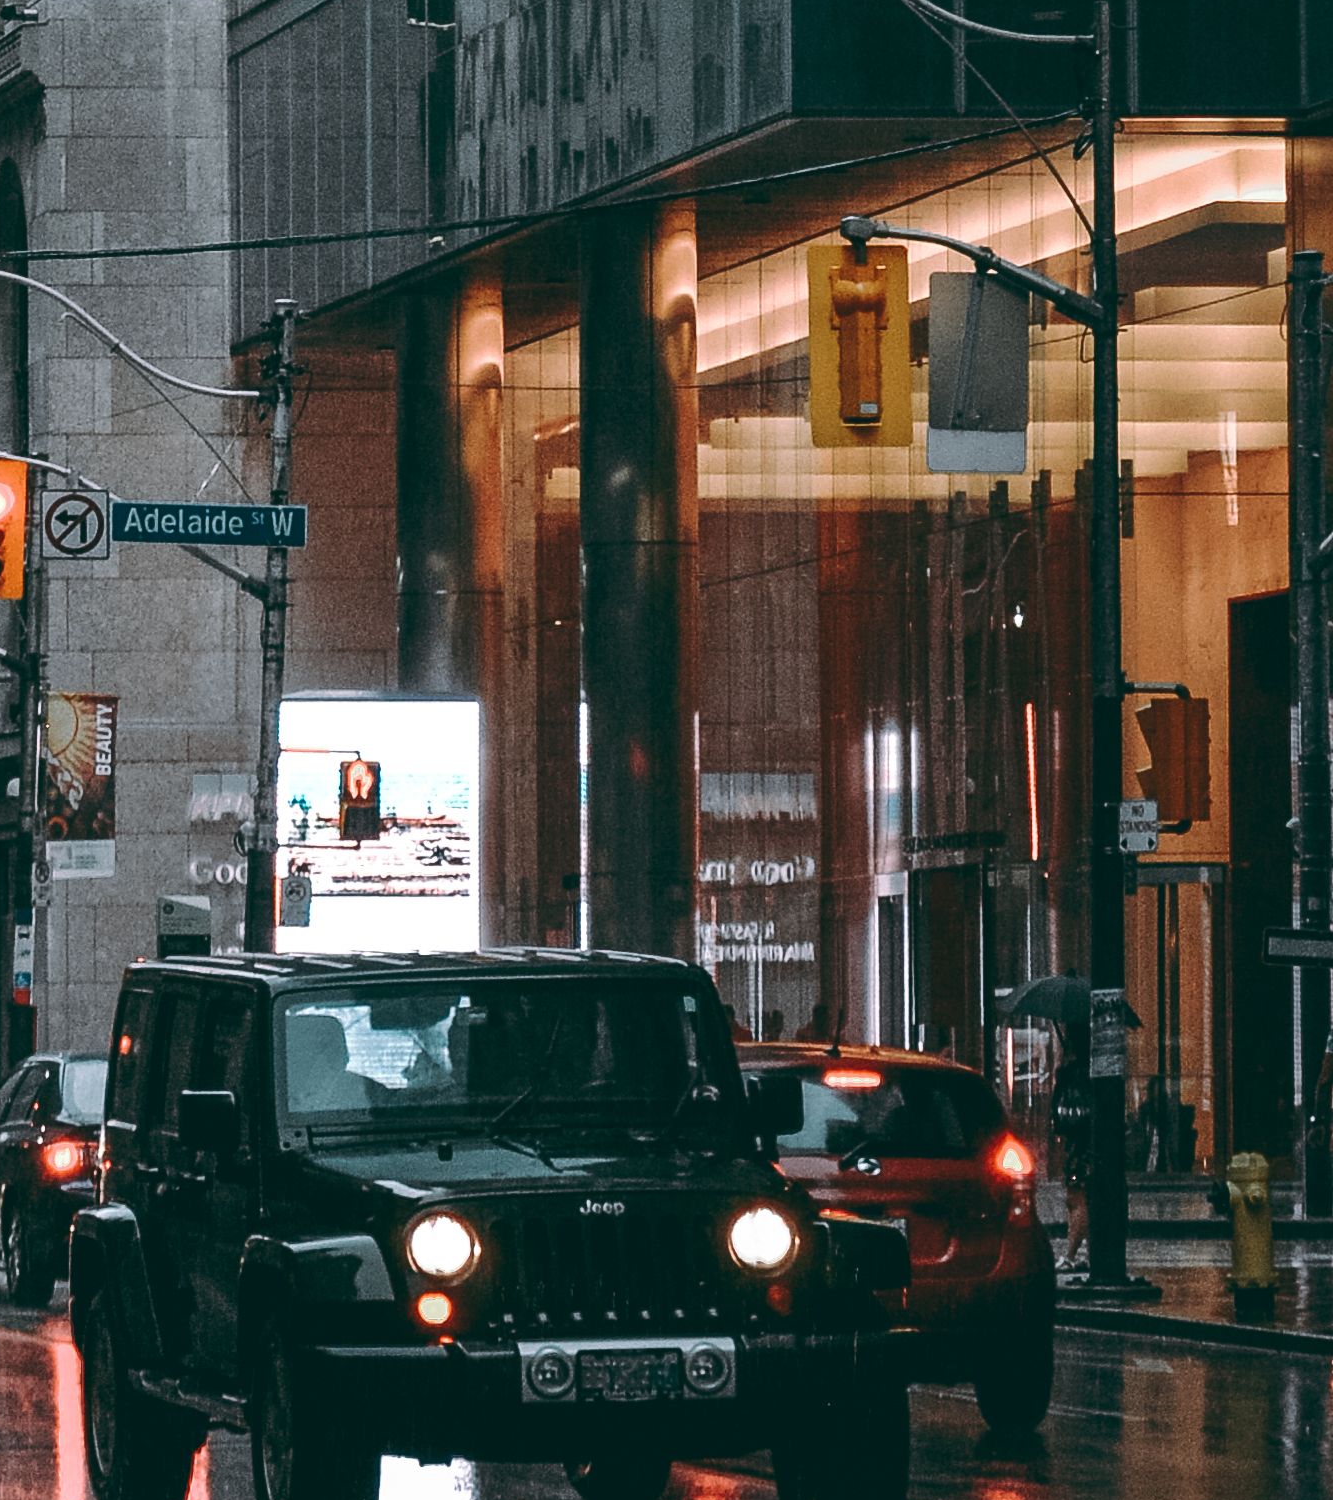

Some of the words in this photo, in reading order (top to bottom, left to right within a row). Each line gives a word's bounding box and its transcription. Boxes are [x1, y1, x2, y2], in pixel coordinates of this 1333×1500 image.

[124, 507, 244, 536] Adelaide
[251, 511, 265, 525] St
[271, 511, 294, 537] W
[95, 703, 114, 777] BEAUTY
[579, 1199, 625, 1217] Jeep
